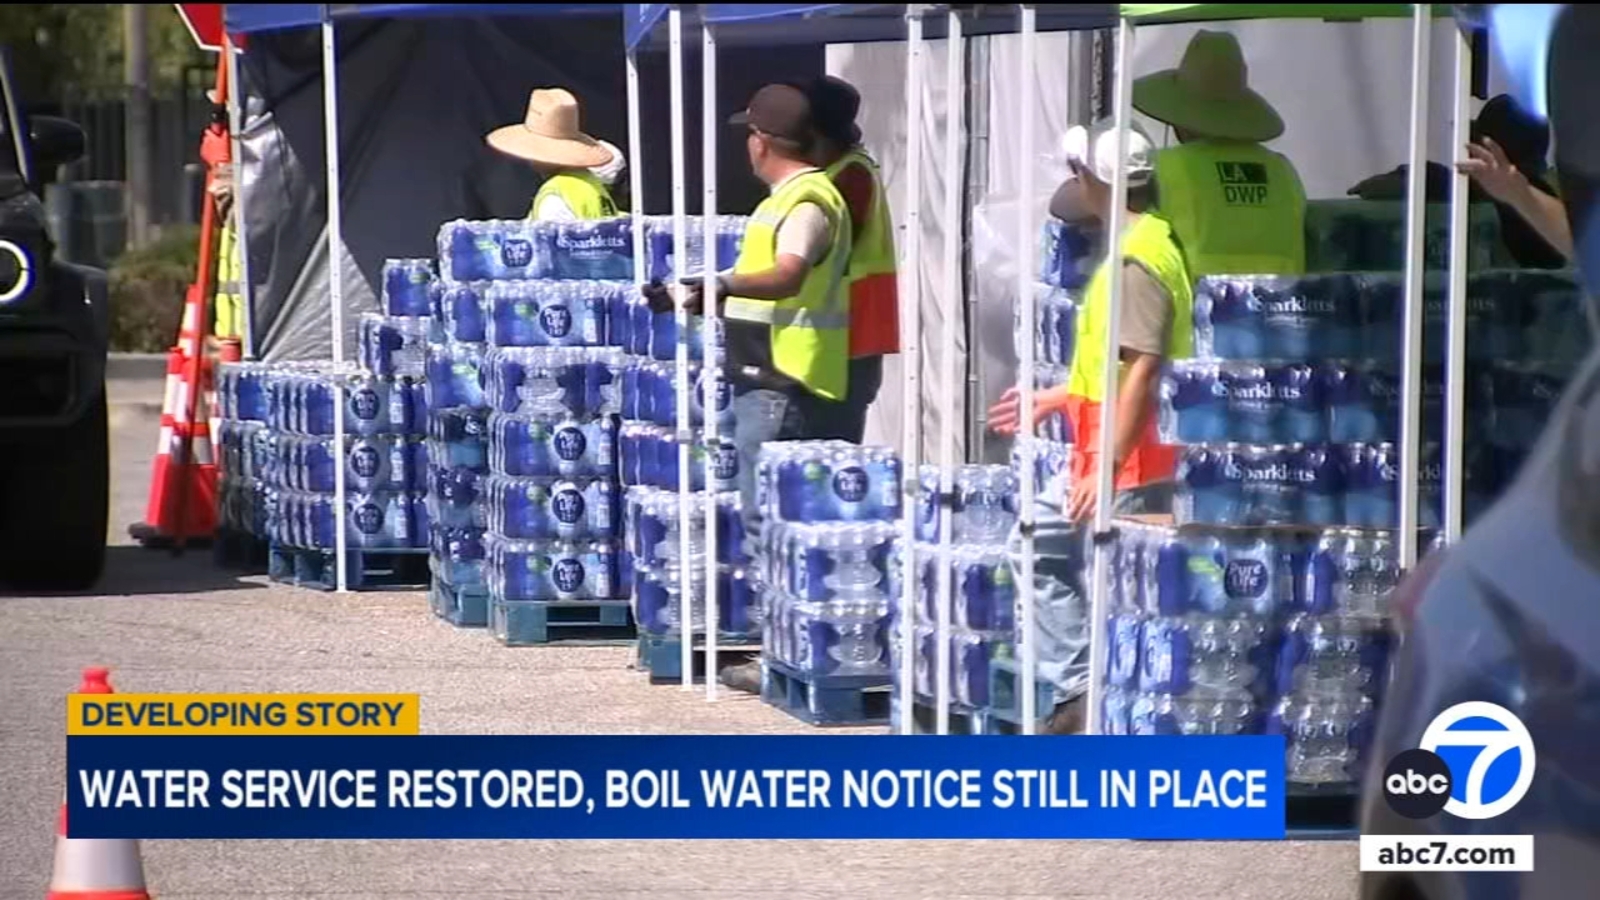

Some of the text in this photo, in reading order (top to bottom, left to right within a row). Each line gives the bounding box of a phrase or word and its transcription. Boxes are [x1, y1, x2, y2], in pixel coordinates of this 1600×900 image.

[1219, 163, 1248, 182] LA
[1225, 186, 1268, 204] DWP
[1229, 561, 1262, 576] Pure
[1231, 574, 1259, 591] Life
